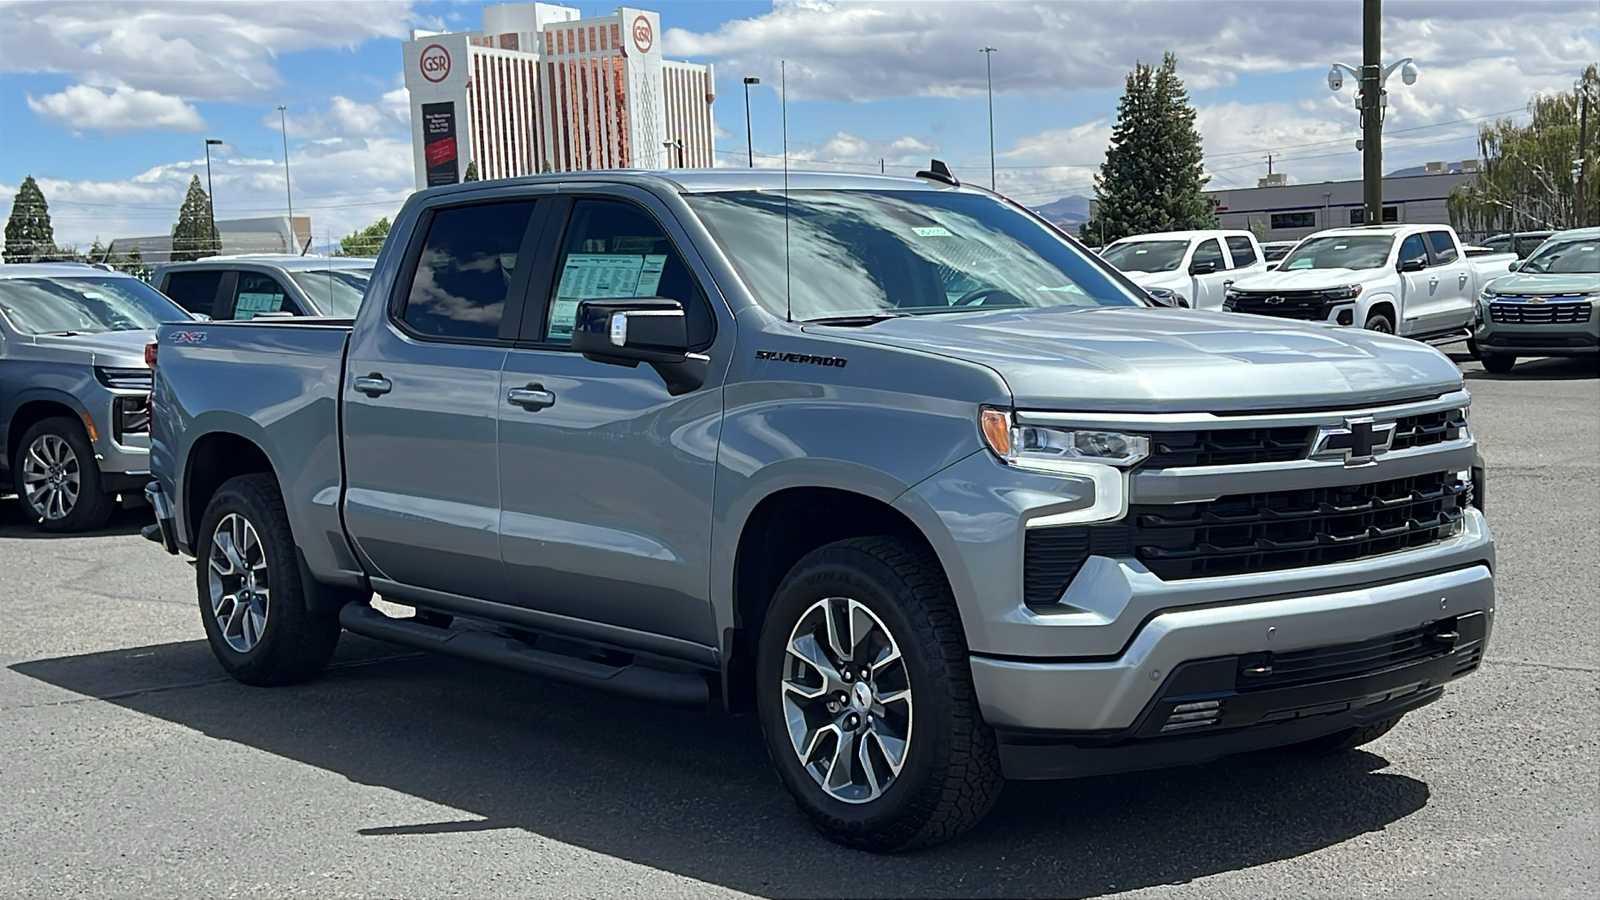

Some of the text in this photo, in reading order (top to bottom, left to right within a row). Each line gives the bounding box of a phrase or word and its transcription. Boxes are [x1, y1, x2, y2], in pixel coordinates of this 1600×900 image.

[634, 25, 651, 43] GSR
[424, 55, 447, 72] GSR
[755, 350, 848, 368] SILVERADO
